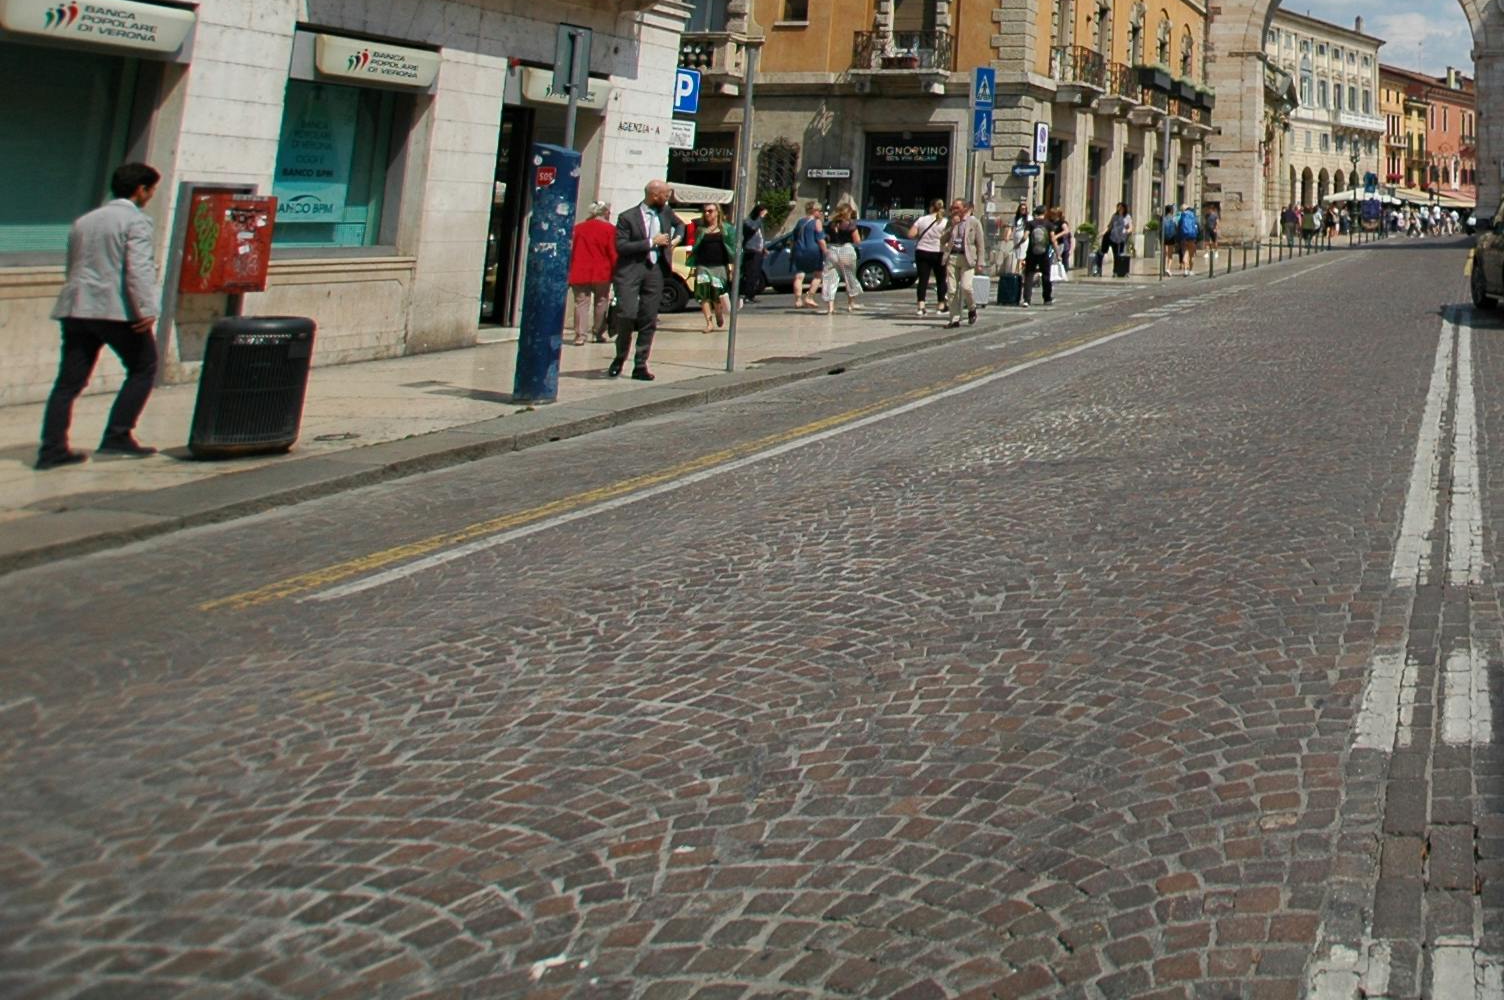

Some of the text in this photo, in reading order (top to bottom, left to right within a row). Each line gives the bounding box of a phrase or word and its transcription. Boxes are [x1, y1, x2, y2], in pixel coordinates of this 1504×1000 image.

[84, 5, 136, 20] BANCA
[81, 14, 158, 33] POPOLARE
[77, 24, 156, 42] DI VERONA
[373, 51, 405, 62] BANCA
[370, 60, 418, 71] POPOLARE
[381, 67, 418, 79] VERONA
[675, 73, 694, 107] P
[875, 145, 949, 156] SIGNORVINO
[283, 168, 314, 177] BANCO
[277, 202, 311, 213] ANCO
